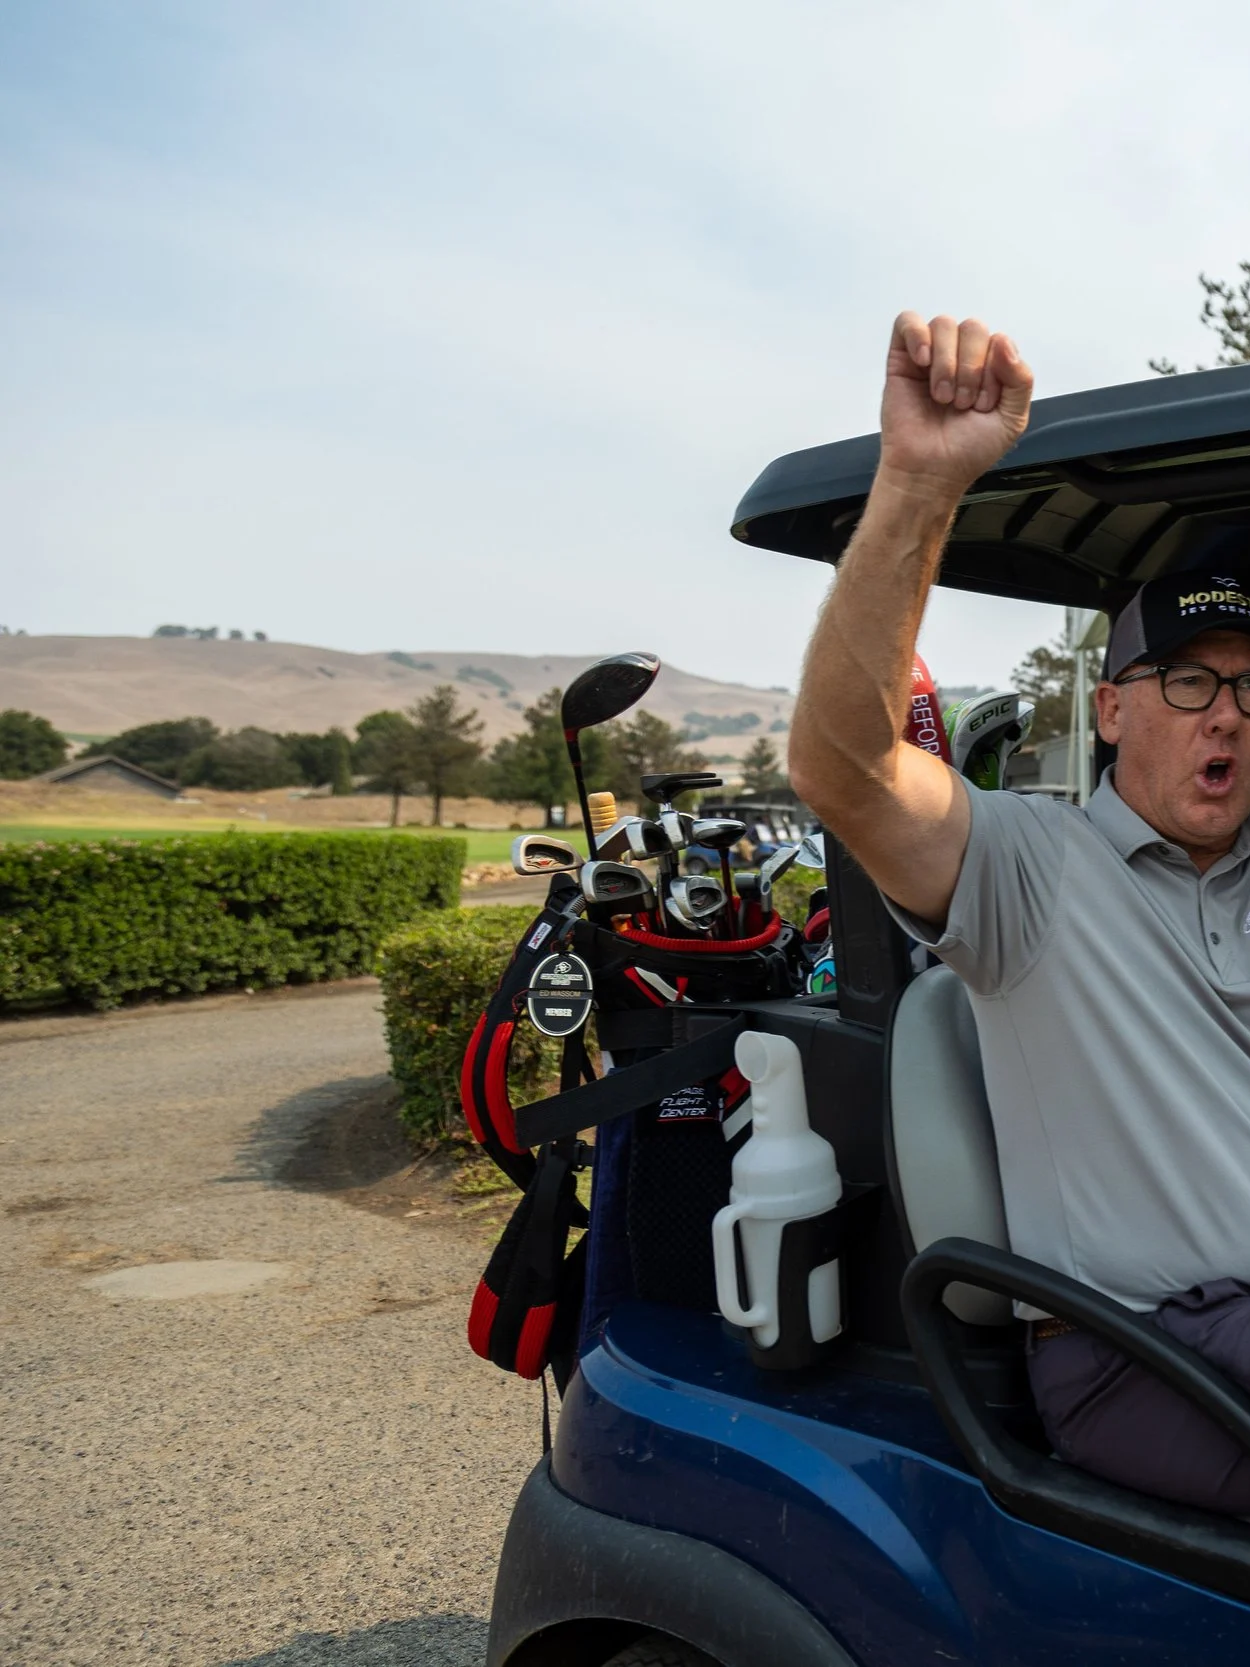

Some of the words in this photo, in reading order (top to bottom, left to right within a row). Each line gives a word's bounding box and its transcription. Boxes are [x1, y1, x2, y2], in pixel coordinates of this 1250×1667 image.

[1180, 605, 1208, 616] JET
[970, 700, 1011, 732] EPIC
[911, 694, 942, 759] BEFOR
[539, 989, 550, 997] ED
[672, 1087, 705, 1096] PACE
[659, 1097, 705, 1107] FLIGHT
[659, 1107, 707, 1118] CENTER
